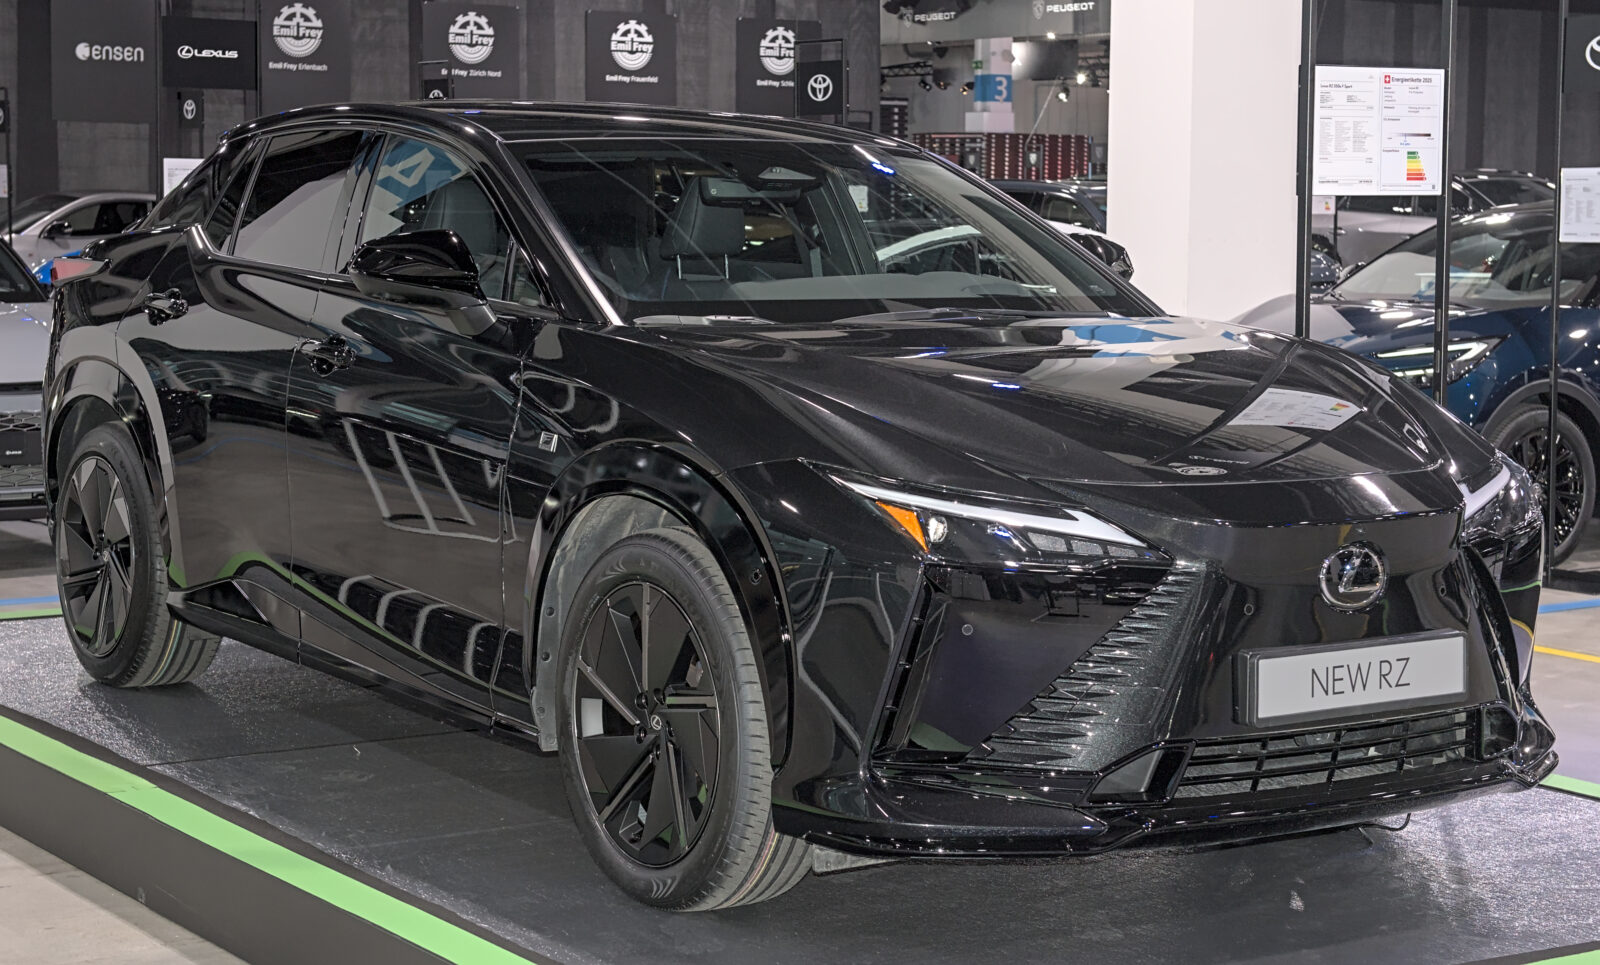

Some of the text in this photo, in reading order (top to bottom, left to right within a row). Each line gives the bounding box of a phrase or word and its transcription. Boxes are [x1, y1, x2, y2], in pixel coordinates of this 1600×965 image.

[1046, 2, 1095, 13] PEUGEOT
[914, 11, 956, 22] PEUGEOT
[273, 25, 323, 40] Emil Frey
[448, 33, 495, 47] Emil Frey
[611, 40, 654, 54] Emil Frey
[759, 46, 795, 57] Emil Fre
[194, 49, 239, 58] LEXUS
[268, 61, 283, 69] Emil
[283, 62, 297, 71] Frey
[455, 69, 468, 77] Frey
[469, 69, 487, 77] Zürich
[487, 70, 502, 78] Nord
[605, 74, 618, 82] Emil
[618, 75, 630, 83] Frey
[756, 79, 768, 87] Emil
[768, 80, 780, 88] Frey
[994, 76, 1008, 100] 3
[1311, 657, 1411, 698] NEW RZ
